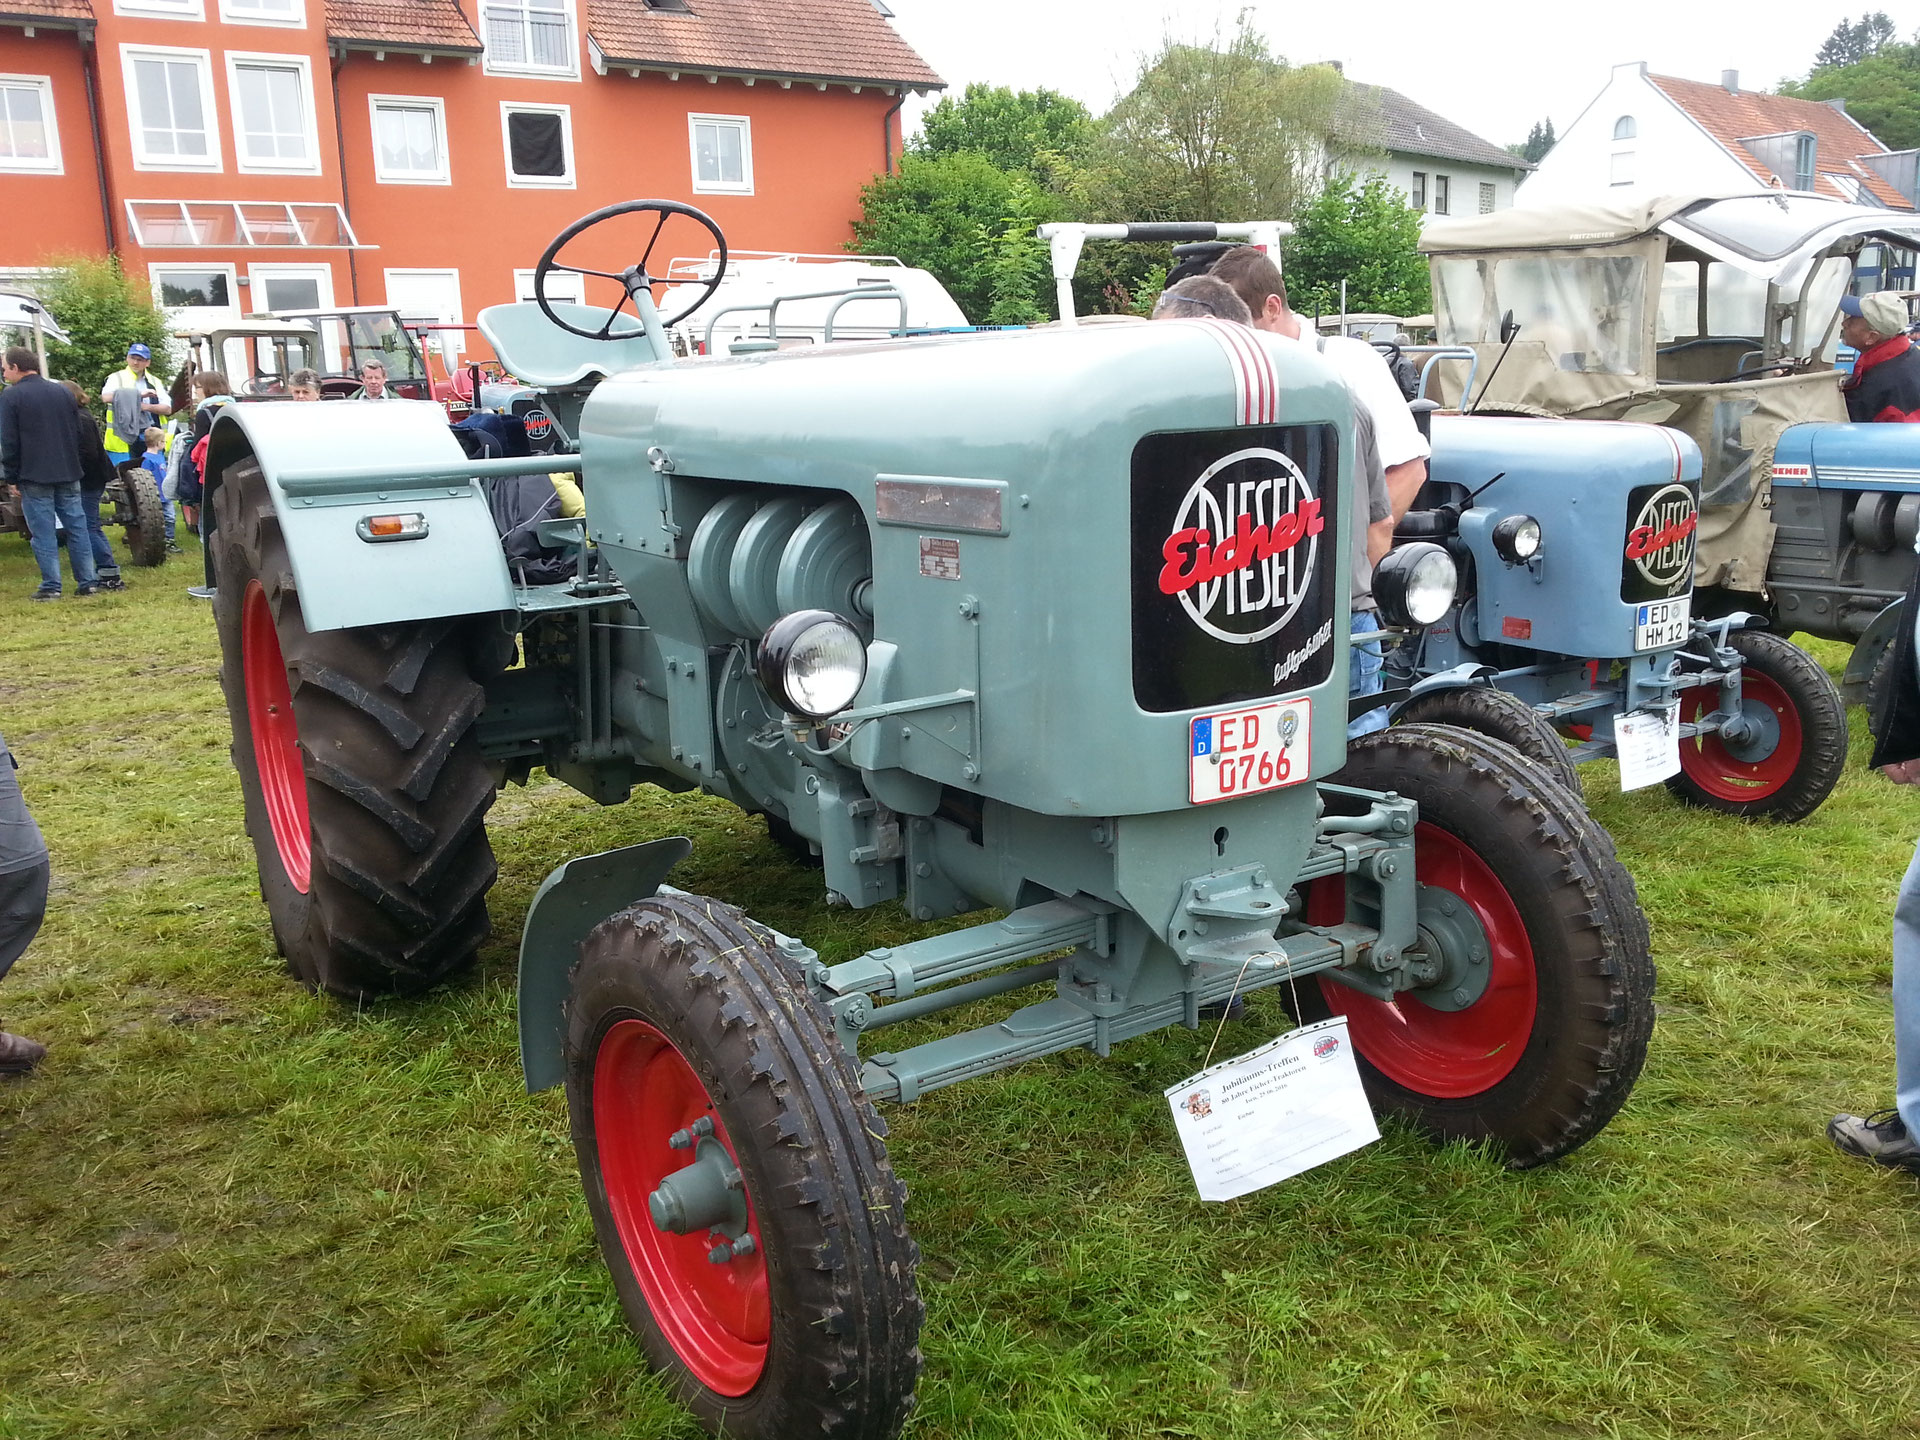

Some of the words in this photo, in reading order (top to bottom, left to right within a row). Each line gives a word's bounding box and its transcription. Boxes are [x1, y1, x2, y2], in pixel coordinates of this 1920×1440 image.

[1158, 498, 1325, 595] Eicher
[1199, 476, 1298, 617] DIESEL
[1625, 510, 1698, 560] Eicher
[1646, 500, 1690, 570] DIESEL
[1646, 627, 1664, 647] HM
[1668, 622, 1683, 642] 12
[1651, 605, 1669, 625] ED
[1197, 741, 1206, 754] D
[1219, 714, 1260, 754] ED
[1219, 747, 1291, 793] 0766
[1221, 1055, 1300, 1094] Jubiläums-Treffen
[1230, 1088, 1249, 1101] Jahre
